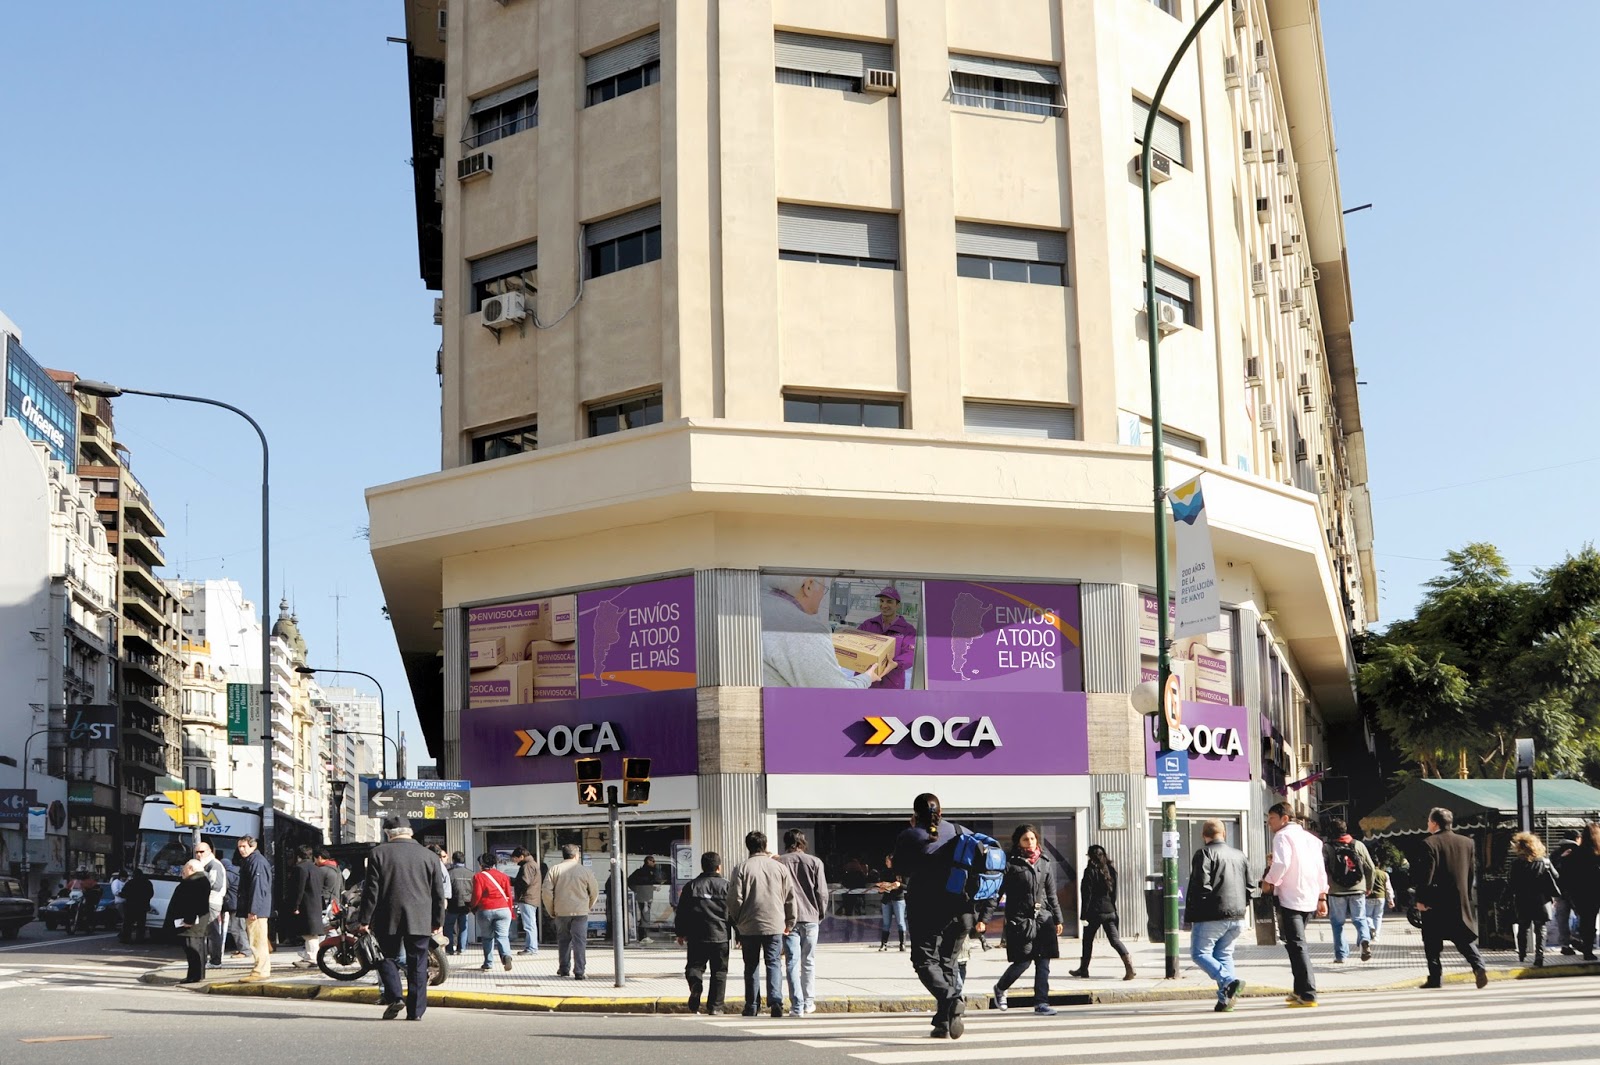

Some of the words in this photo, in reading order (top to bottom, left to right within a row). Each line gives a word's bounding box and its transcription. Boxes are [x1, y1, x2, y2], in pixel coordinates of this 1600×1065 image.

[1182, 568, 1192, 577] 200
[1182, 578, 1189, 586] DE
[1190, 576, 1195, 584] LA
[1181, 596, 1188, 604] DE
[1189, 591, 1205, 602] MAYO
[477, 609, 538, 621] ENVIOSOCA.com
[629, 601, 680, 626] ENVÍOS
[995, 603, 1056, 625] ENVÍOS
[629, 630, 640, 648] A
[640, 625, 680, 647] TODO
[996, 628, 1009, 646] A
[1008, 629, 1056, 647] TODO
[631, 652, 648, 670] EL
[649, 644, 680, 668] PAÍS
[998, 651, 1019, 668] EL
[1021, 647, 1056, 669] PAÍS
[547, 721, 621, 757] OCA
[910, 715, 1003, 748] OCA
[1193, 724, 1244, 756] OCA
[406, 790, 436, 798] Cerrito
